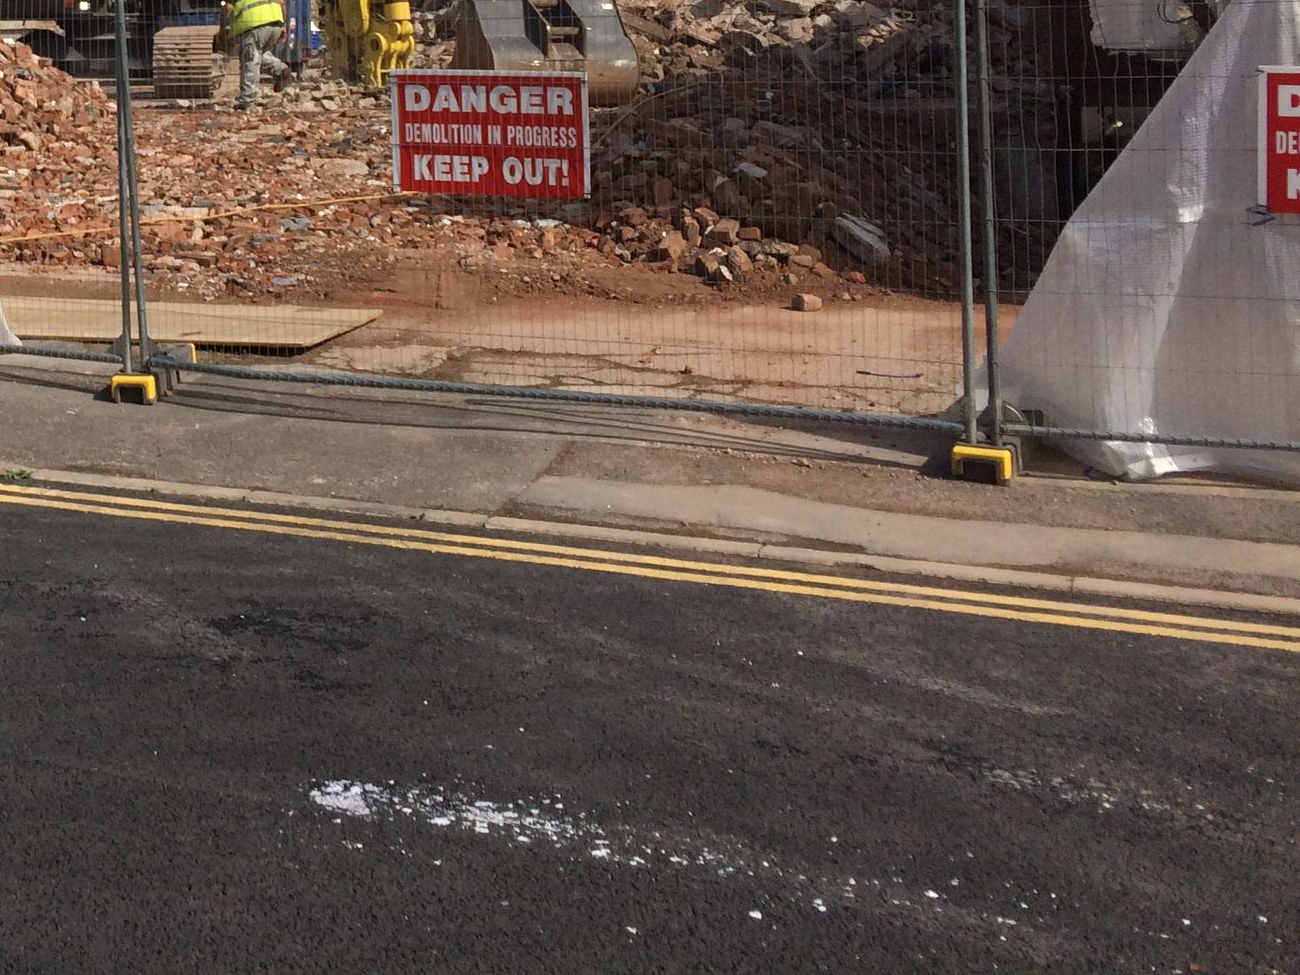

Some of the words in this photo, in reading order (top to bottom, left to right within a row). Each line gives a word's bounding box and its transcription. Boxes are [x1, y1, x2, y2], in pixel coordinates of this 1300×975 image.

[404, 84, 574, 115] DANGER
[405, 122, 482, 145] DEMOLITION
[488, 125, 500, 145] IN
[507, 126, 577, 148] PROGRESS
[413, 154, 489, 183] KEEP
[502, 156, 570, 186] OUT!
